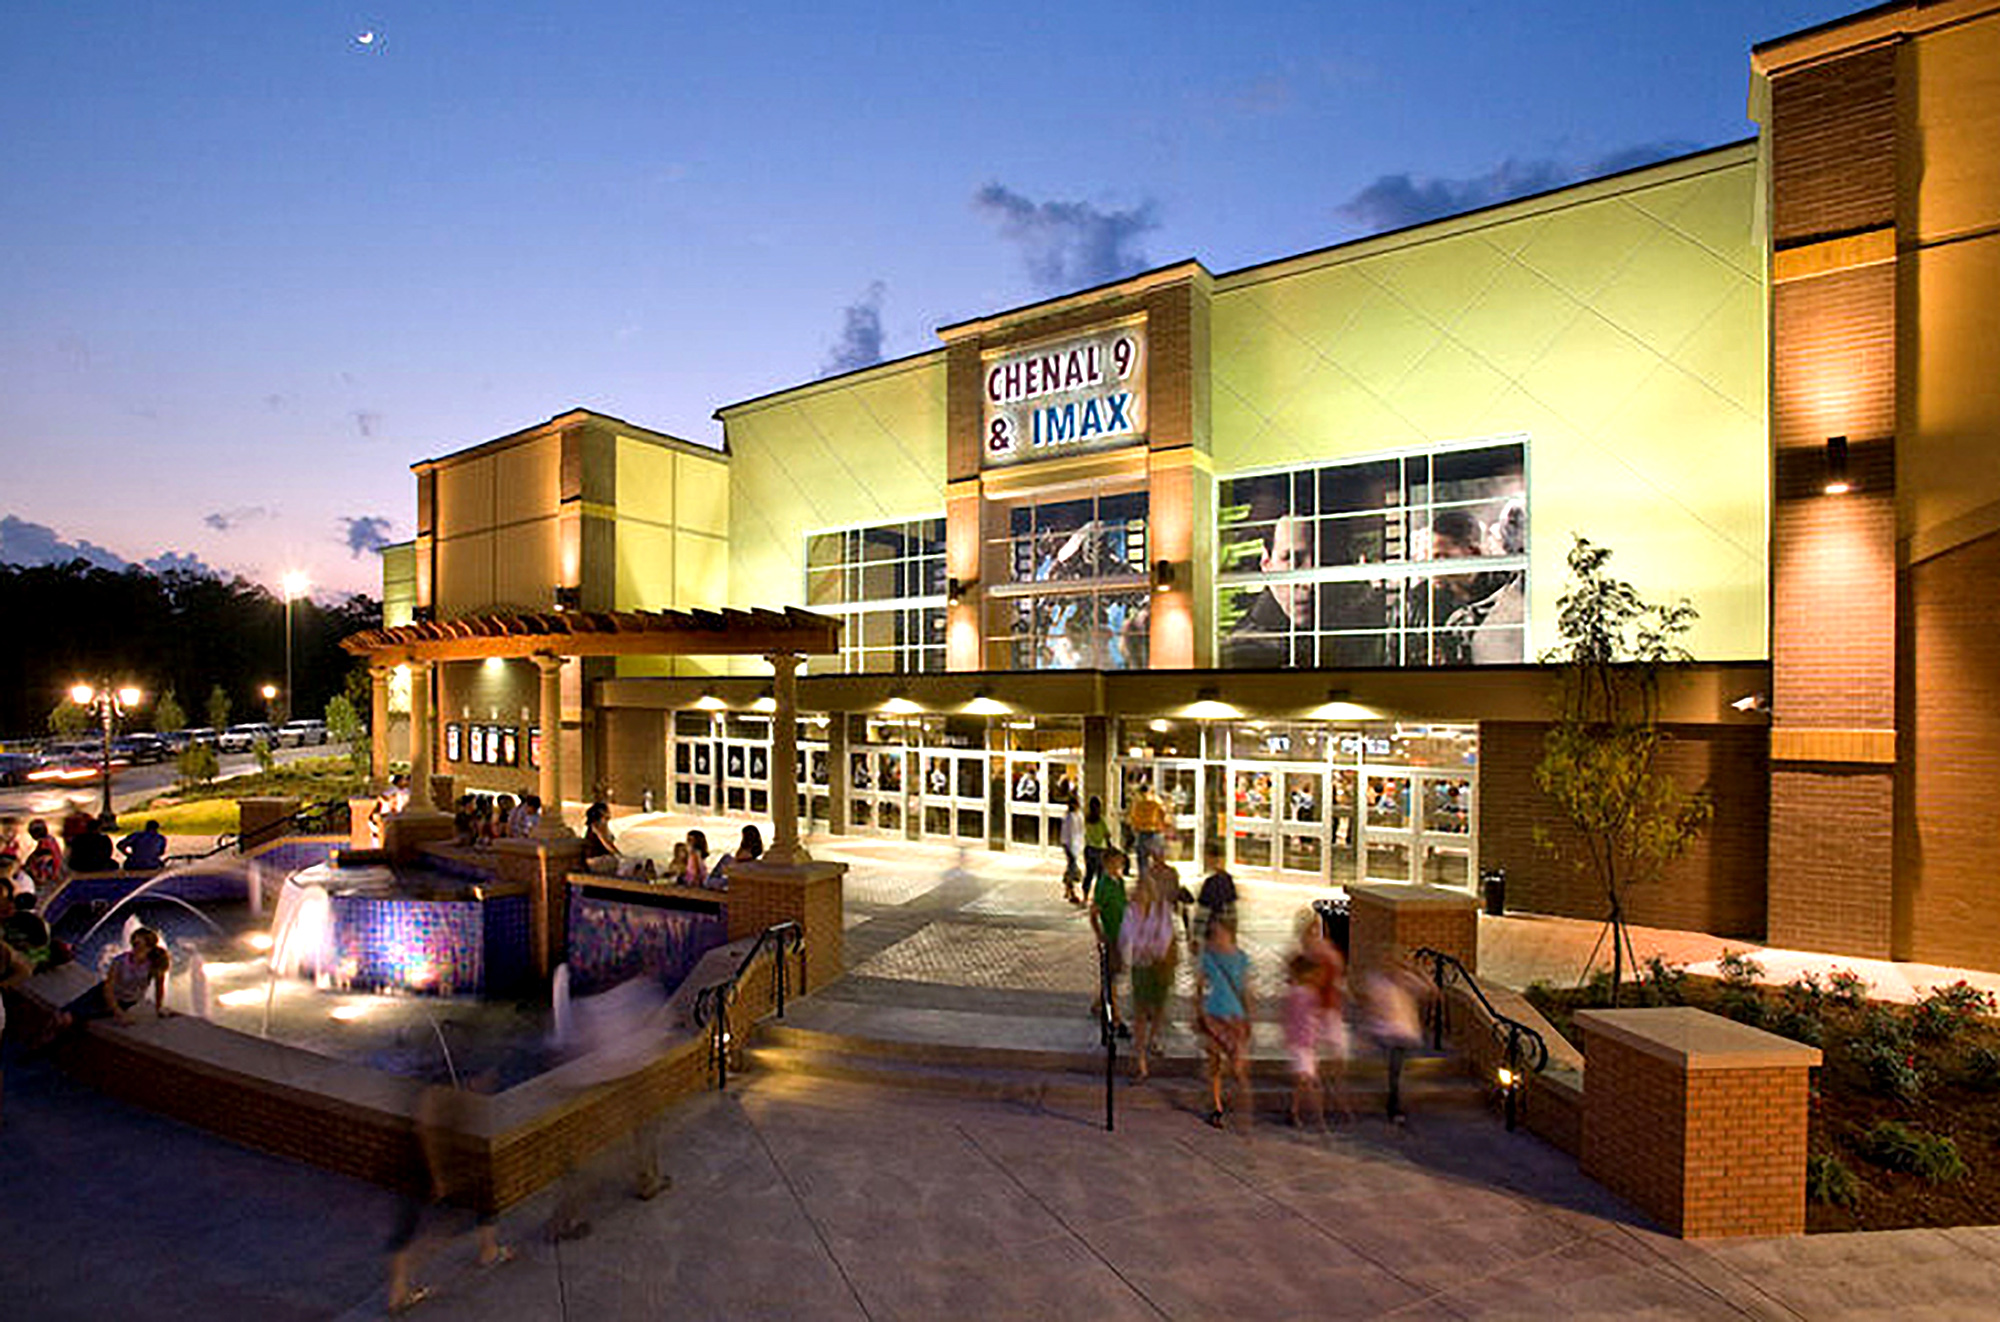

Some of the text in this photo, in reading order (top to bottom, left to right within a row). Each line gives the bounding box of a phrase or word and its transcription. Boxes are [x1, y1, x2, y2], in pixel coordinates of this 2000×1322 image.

[988, 337, 1132, 402] CHENAL 9
[989, 393, 1129, 451] & IMAX
